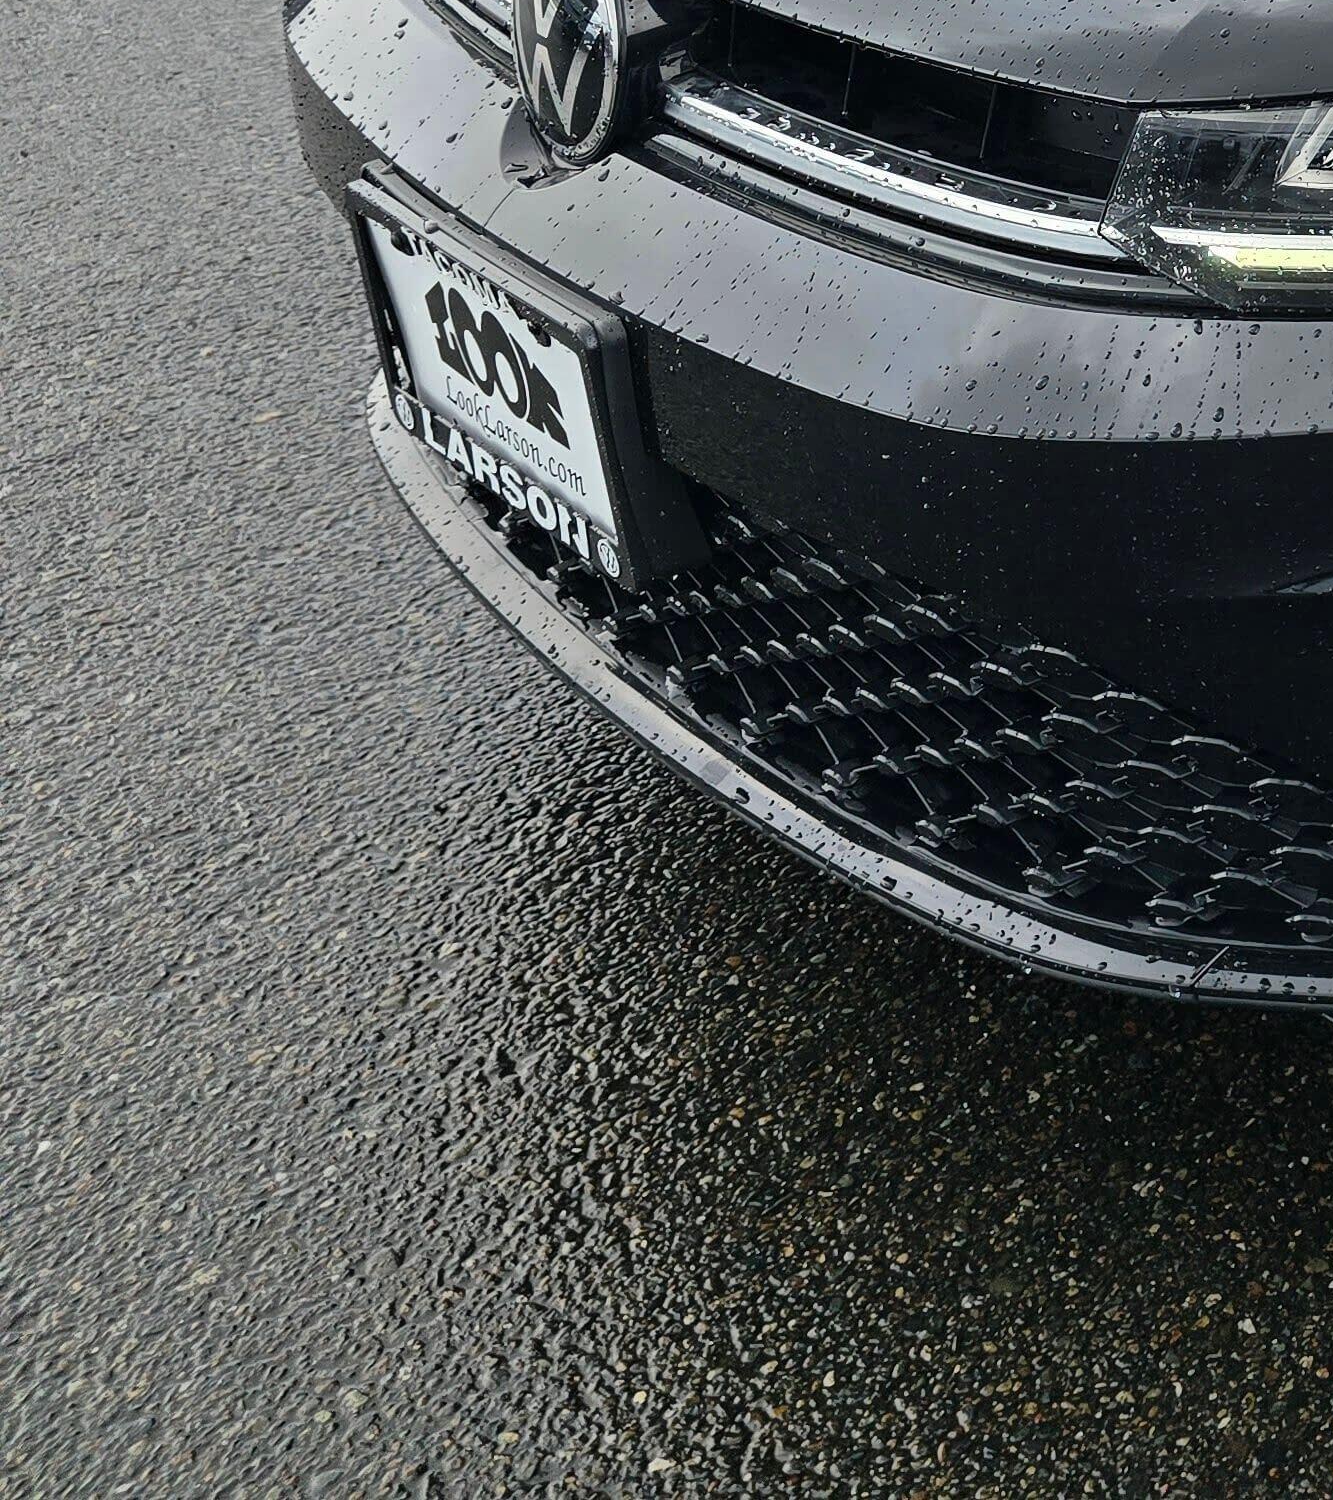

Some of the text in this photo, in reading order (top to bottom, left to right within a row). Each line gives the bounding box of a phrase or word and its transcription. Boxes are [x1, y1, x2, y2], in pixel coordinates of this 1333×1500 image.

[425, 281, 571, 451] LOOK
[446, 376, 587, 497] LookLarson.com
[421, 407, 592, 560] LARSON
